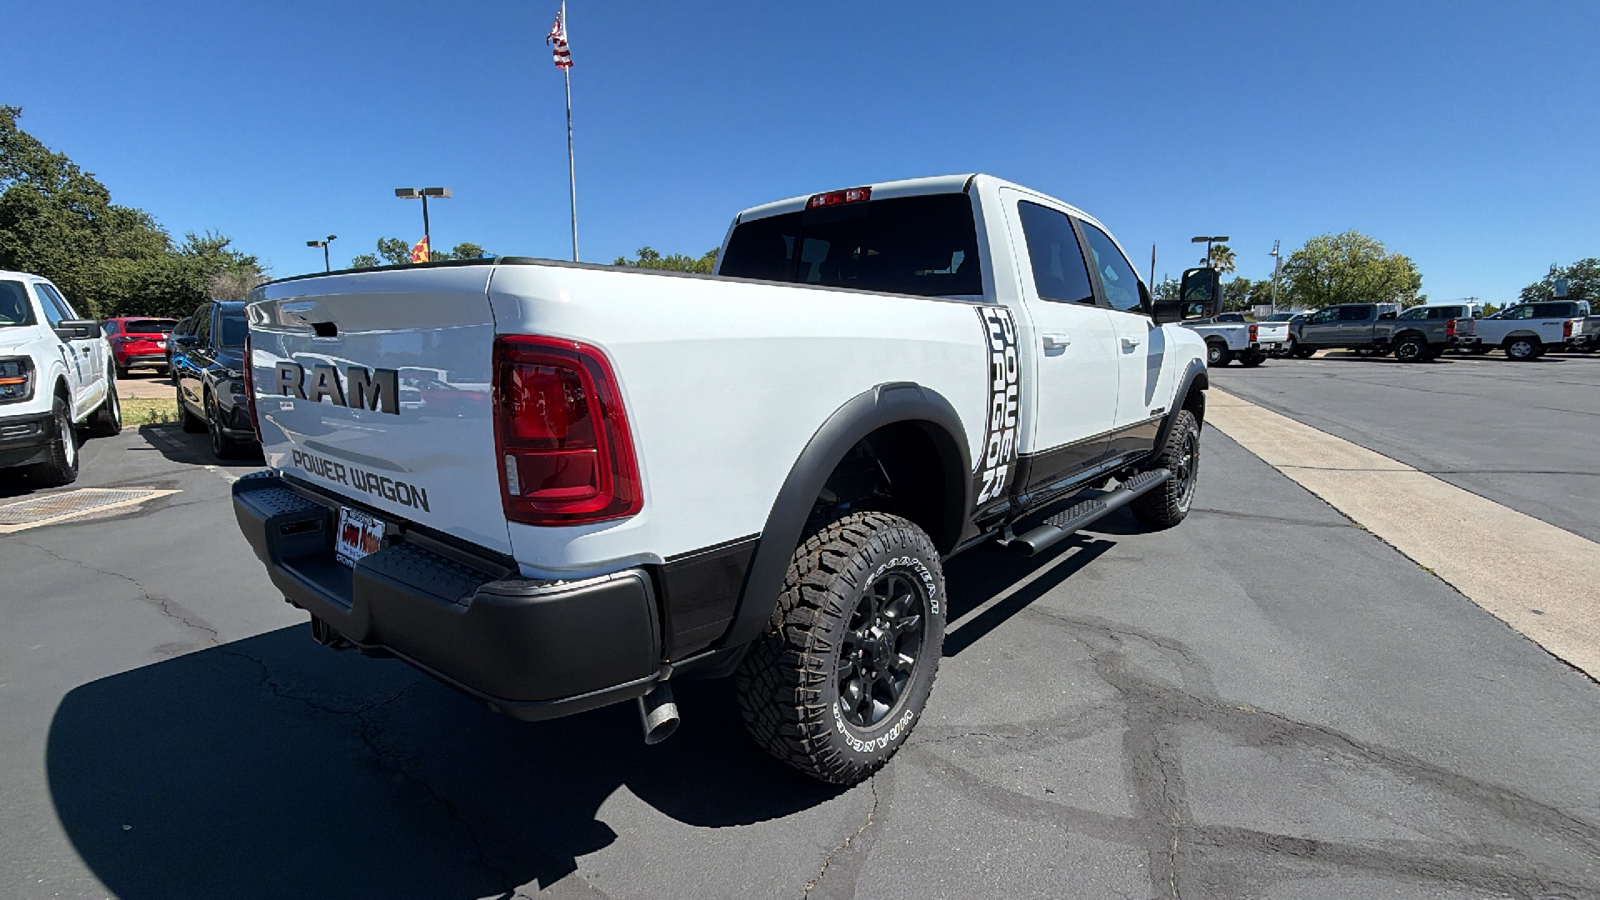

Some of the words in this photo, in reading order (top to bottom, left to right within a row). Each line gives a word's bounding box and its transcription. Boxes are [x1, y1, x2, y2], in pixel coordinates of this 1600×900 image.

[275, 361, 401, 415] RAM
[976, 308, 1006, 505] WAGON
[992, 308, 1018, 498] POWER
[292, 449, 349, 485] POWER
[349, 467, 431, 513] WAGON
[862, 556, 939, 615] GOODYEAR
[832, 701, 914, 752] WRANGLER
